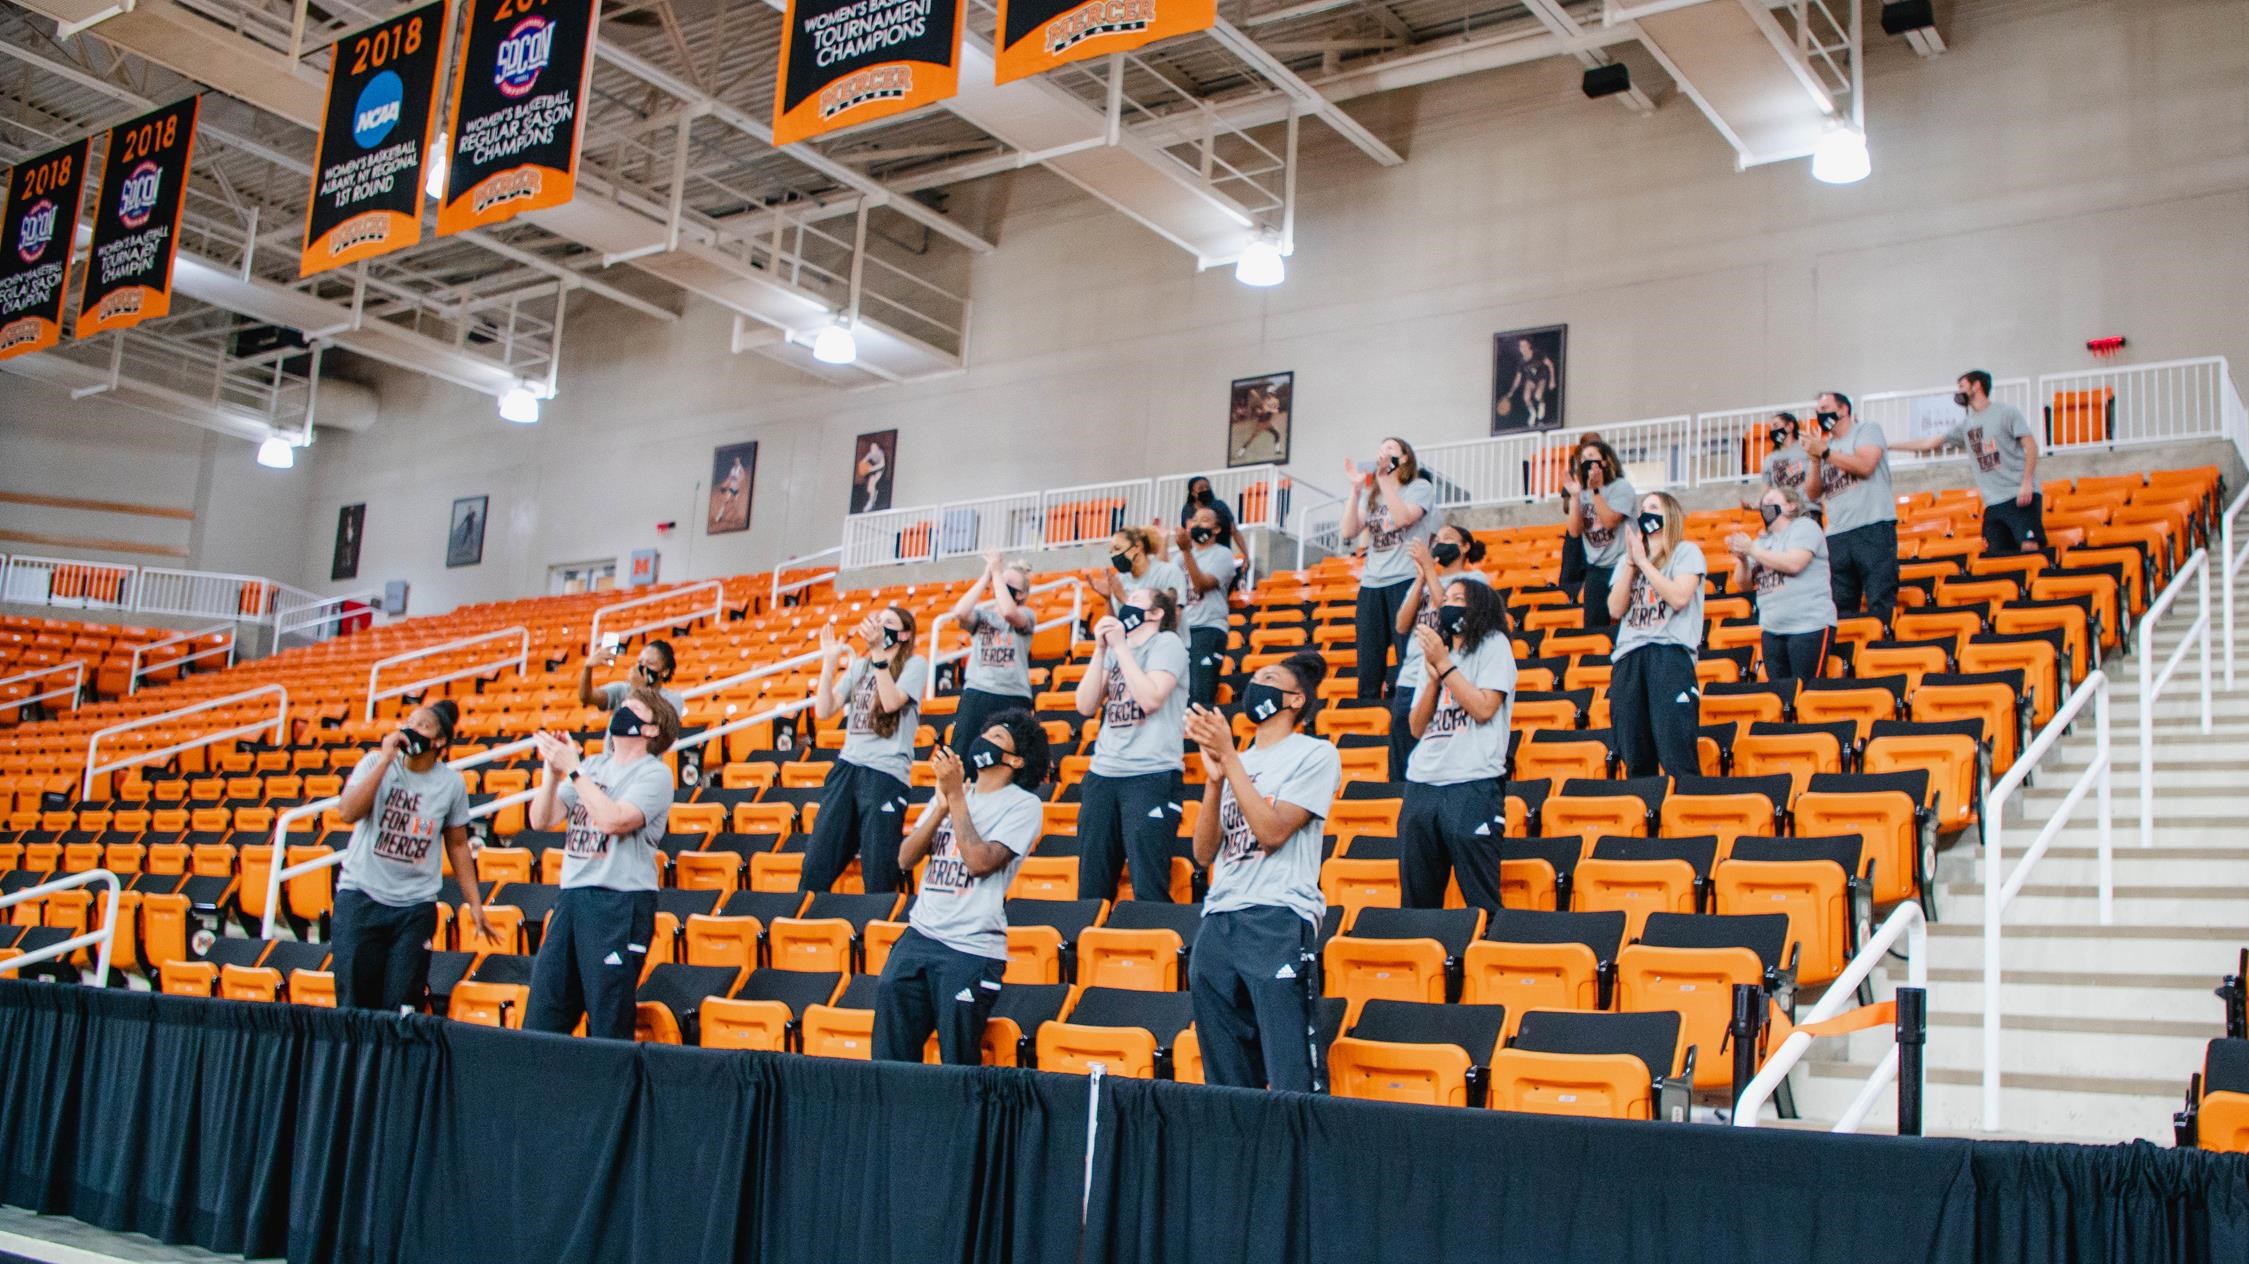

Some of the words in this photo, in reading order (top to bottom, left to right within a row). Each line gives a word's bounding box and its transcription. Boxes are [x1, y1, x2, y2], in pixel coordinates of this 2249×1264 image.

[804, 1, 867, 33] WOMEN'S
[814, 0, 932, 49] TOURNAMENT
[1044, 0, 1156, 52] MERCER
[352, 16, 423, 75] 2018
[816, 17, 926, 67] CHAMPIONS
[122, 115, 177, 163] 2018
[355, 101, 400, 134] NCAA
[458, 119, 520, 154] REGULAR
[522, 102, 574, 135] SASON
[465, 106, 514, 133] WOMEN'S
[21, 155, 72, 200] 2018
[335, 188, 352, 208] 1ST
[352, 175, 394, 202] ROUND
[379, 808, 410, 832] FOR
[385, 788, 421, 811] HERE
